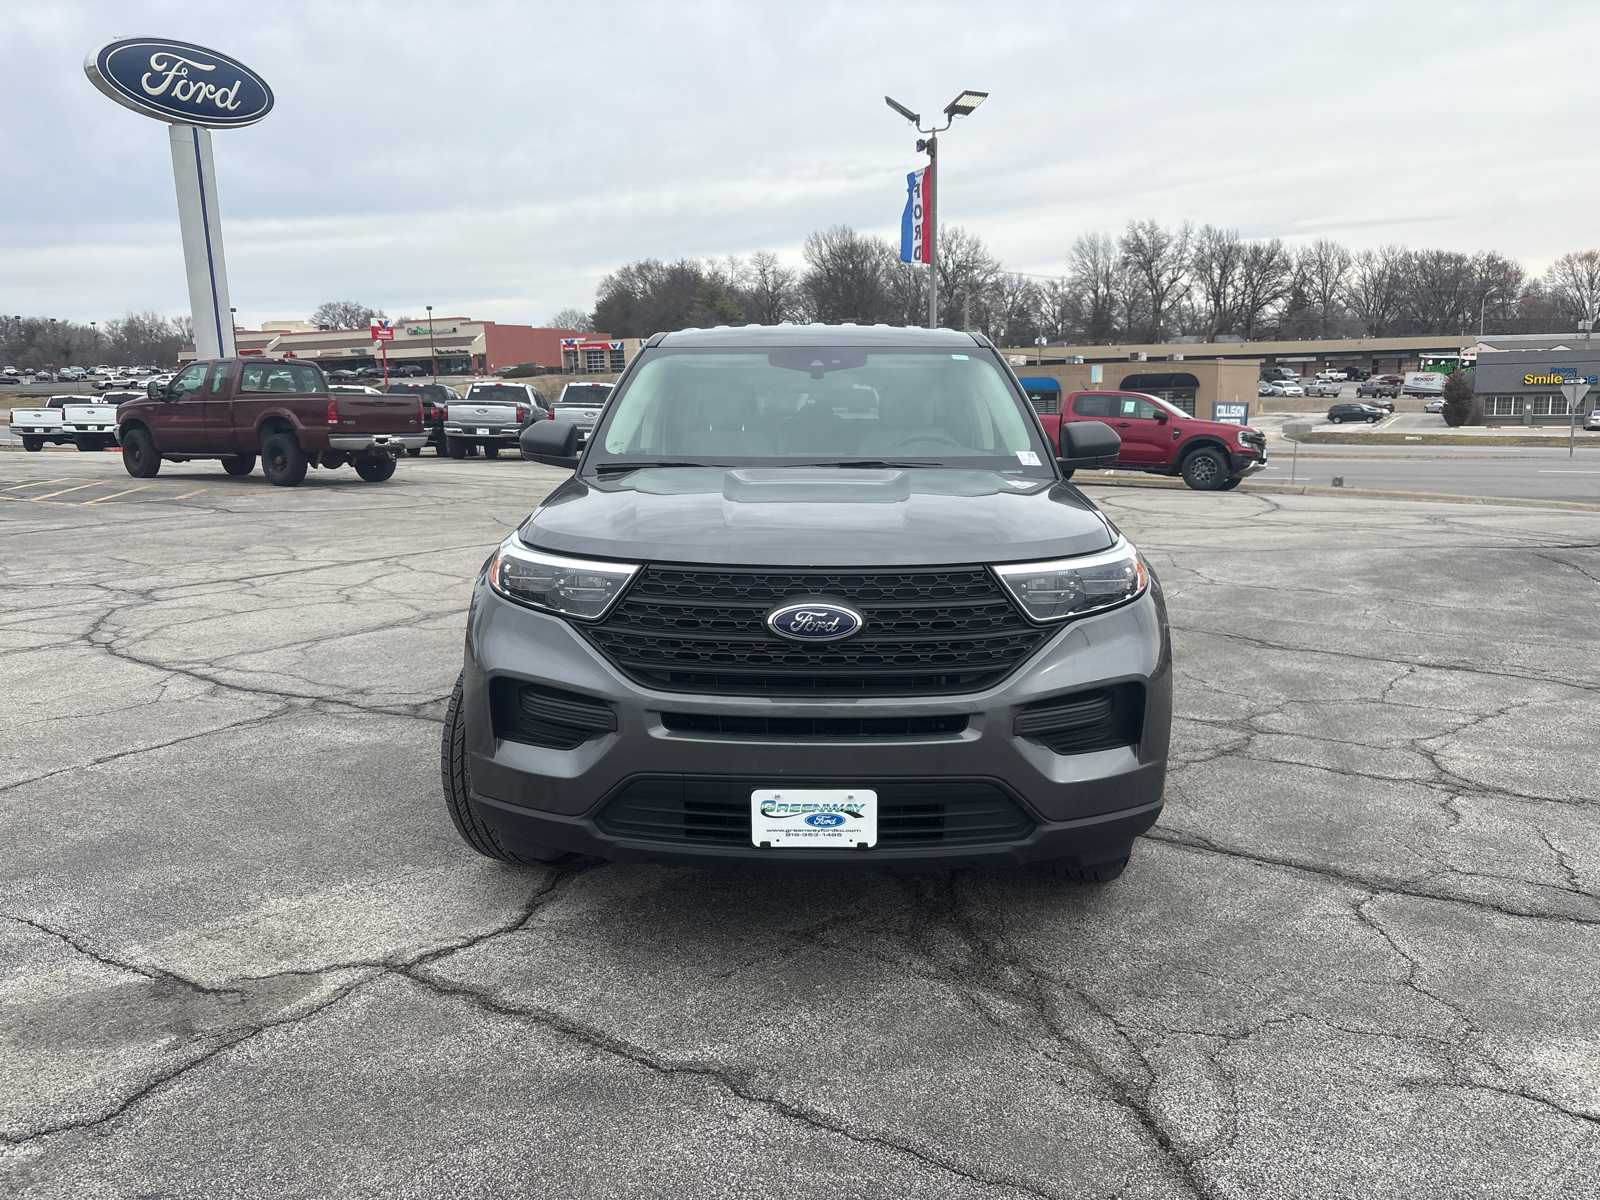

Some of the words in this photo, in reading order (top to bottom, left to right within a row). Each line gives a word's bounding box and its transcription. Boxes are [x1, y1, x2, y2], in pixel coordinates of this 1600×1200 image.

[141, 52, 242, 111] Ford
[1524, 373, 1563, 385] Smile
[1216, 405, 1245, 417] COLLISION
[789, 611, 840, 632] Ford
[759, 800, 866, 813] GREENWAY
[813, 815, 837, 825] Ford
